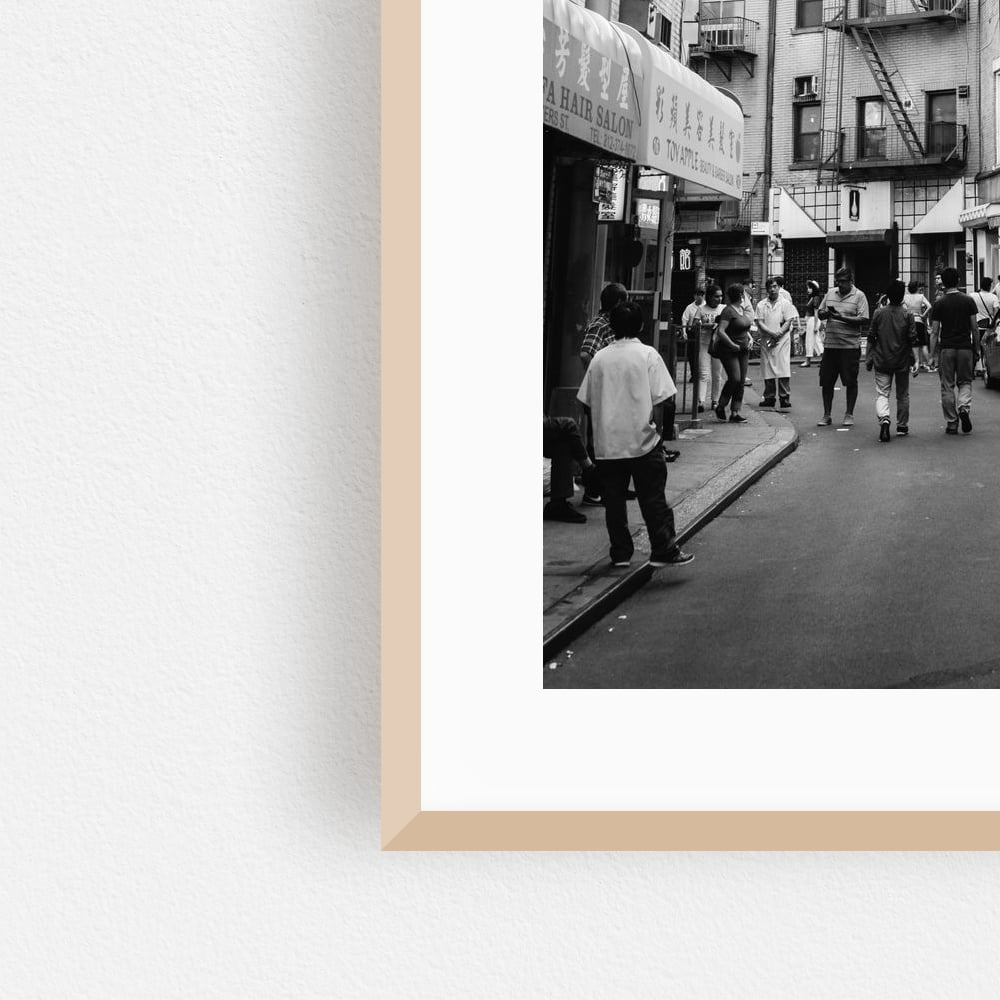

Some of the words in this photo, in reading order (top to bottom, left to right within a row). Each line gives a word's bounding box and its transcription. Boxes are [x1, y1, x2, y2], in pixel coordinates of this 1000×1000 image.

[560, 85, 593, 123] HAIR
[596, 104, 634, 140] SALON
[680, 145, 699, 171] APPLE
